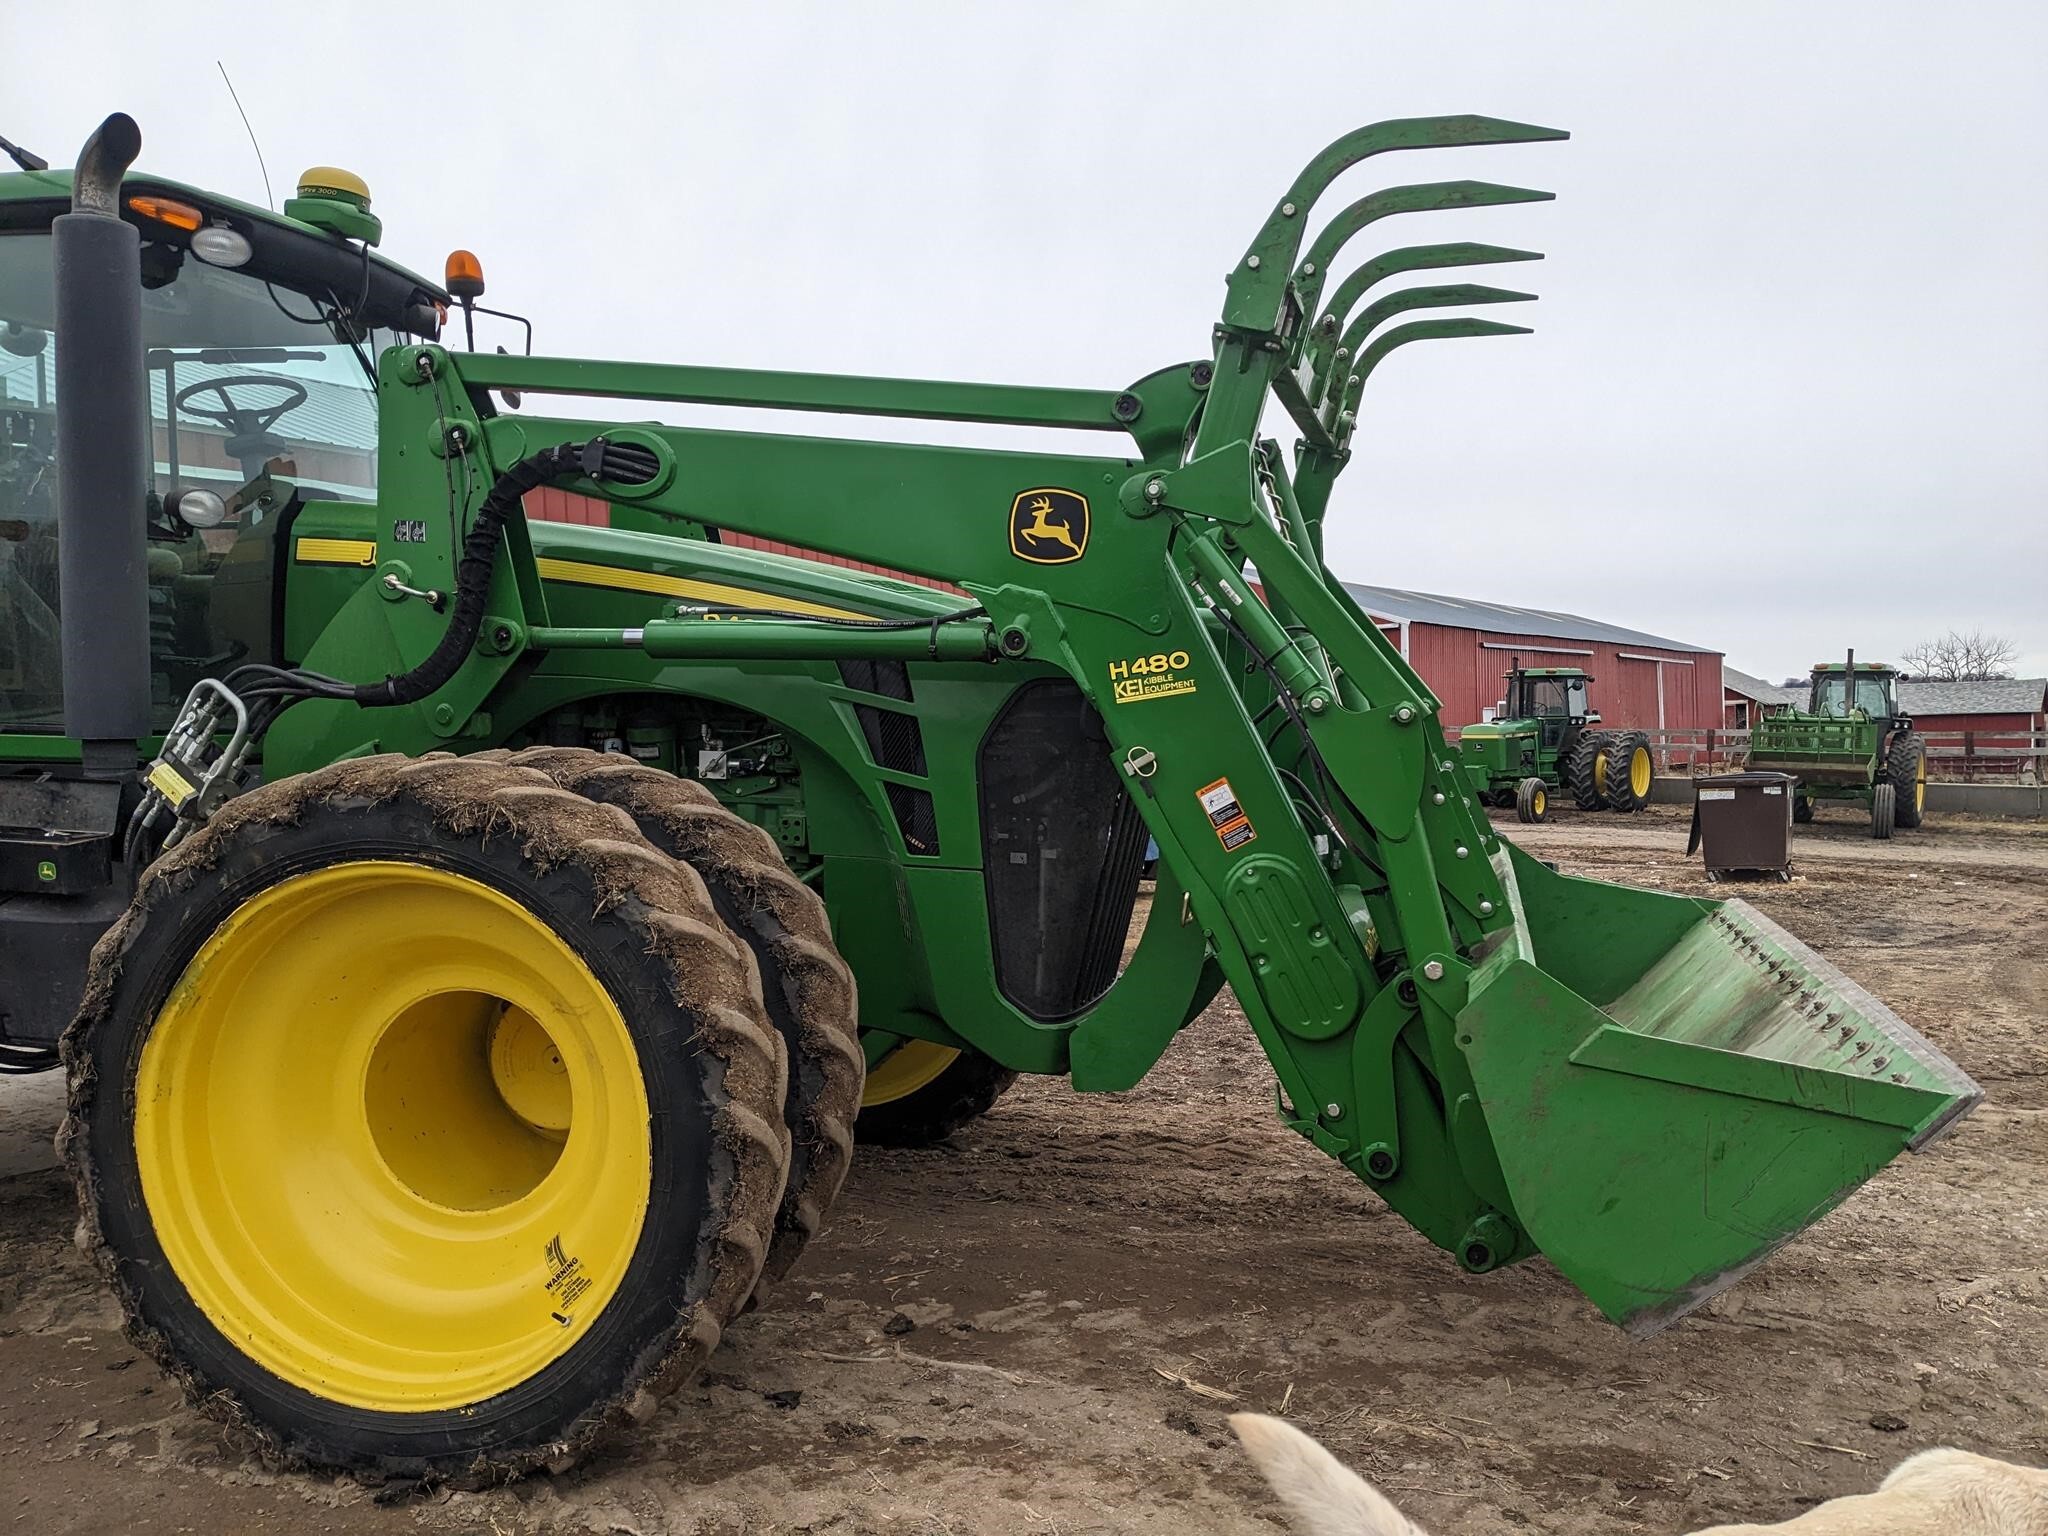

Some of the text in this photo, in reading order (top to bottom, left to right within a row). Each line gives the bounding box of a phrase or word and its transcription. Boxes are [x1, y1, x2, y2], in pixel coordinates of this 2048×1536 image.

[1109, 651, 1190, 680] H480
[1143, 674, 1174, 686] KIBBLE
[1144, 679, 1195, 694] EQUIPMENT
[544, 1256, 579, 1290] WARNING
